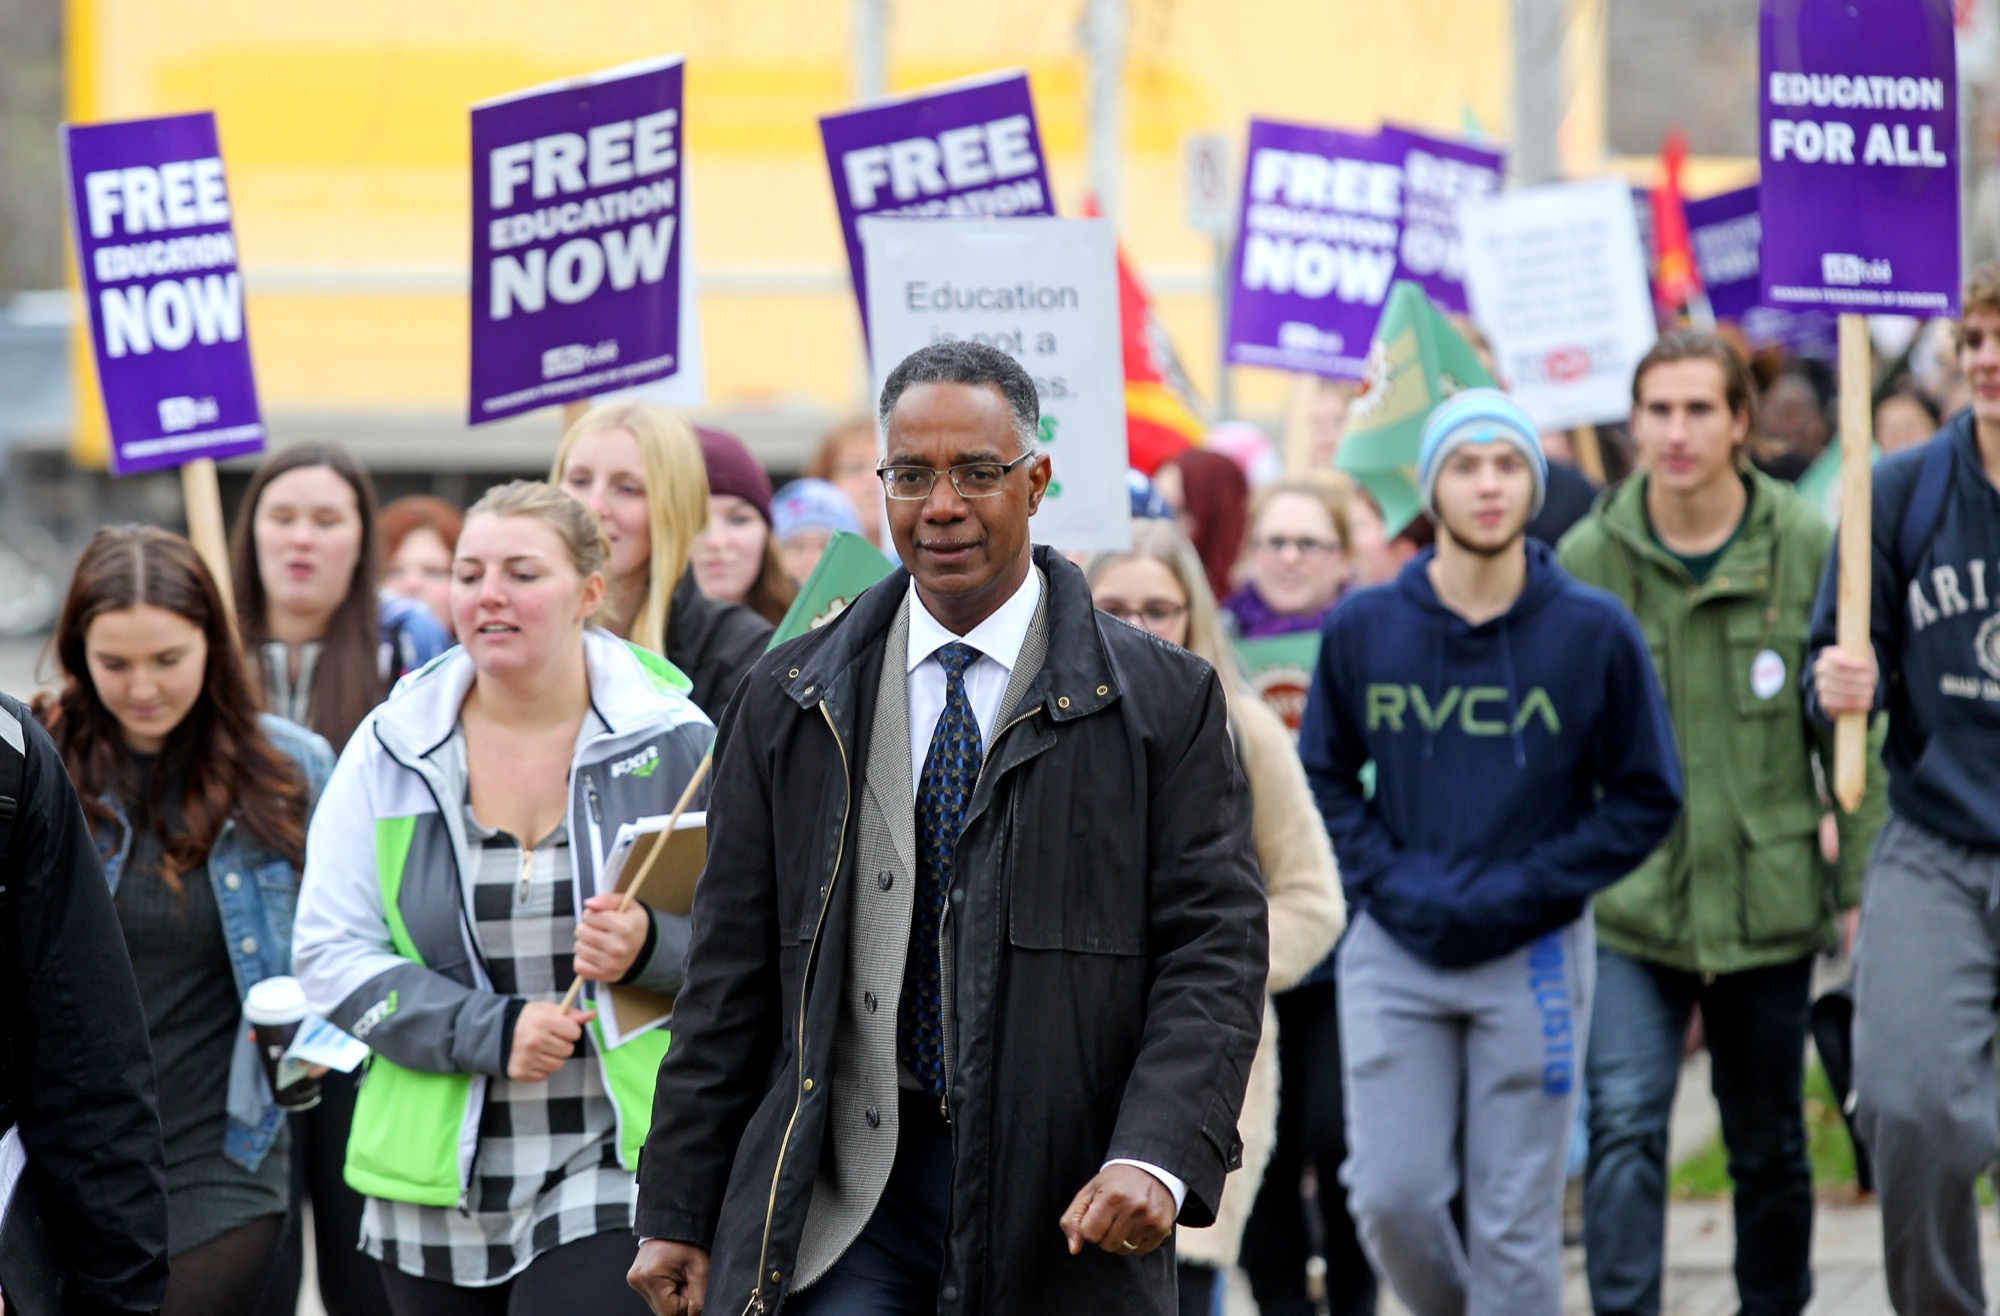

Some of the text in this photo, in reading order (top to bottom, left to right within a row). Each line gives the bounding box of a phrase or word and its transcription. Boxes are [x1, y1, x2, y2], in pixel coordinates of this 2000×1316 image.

[1769, 72, 1945, 111] EDUCATION
[490, 107, 678, 210] FREE
[842, 114, 1038, 209] FREE
[1770, 118, 1947, 168] FOR ALL
[85, 157, 230, 239] FREE
[489, 178, 676, 251] EDUCATION
[1253, 147, 1402, 218] FREE
[94, 231, 237, 283] EDUCATION
[490, 214, 677, 321] NOW
[1242, 235, 1397, 306] NOW
[101, 271, 243, 358] NOW
[906, 280, 1079, 312] Education
[1035, 331, 1057, 355] a
[1908, 558, 2000, 632] ARI
[1366, 683, 1561, 736] RVCA
